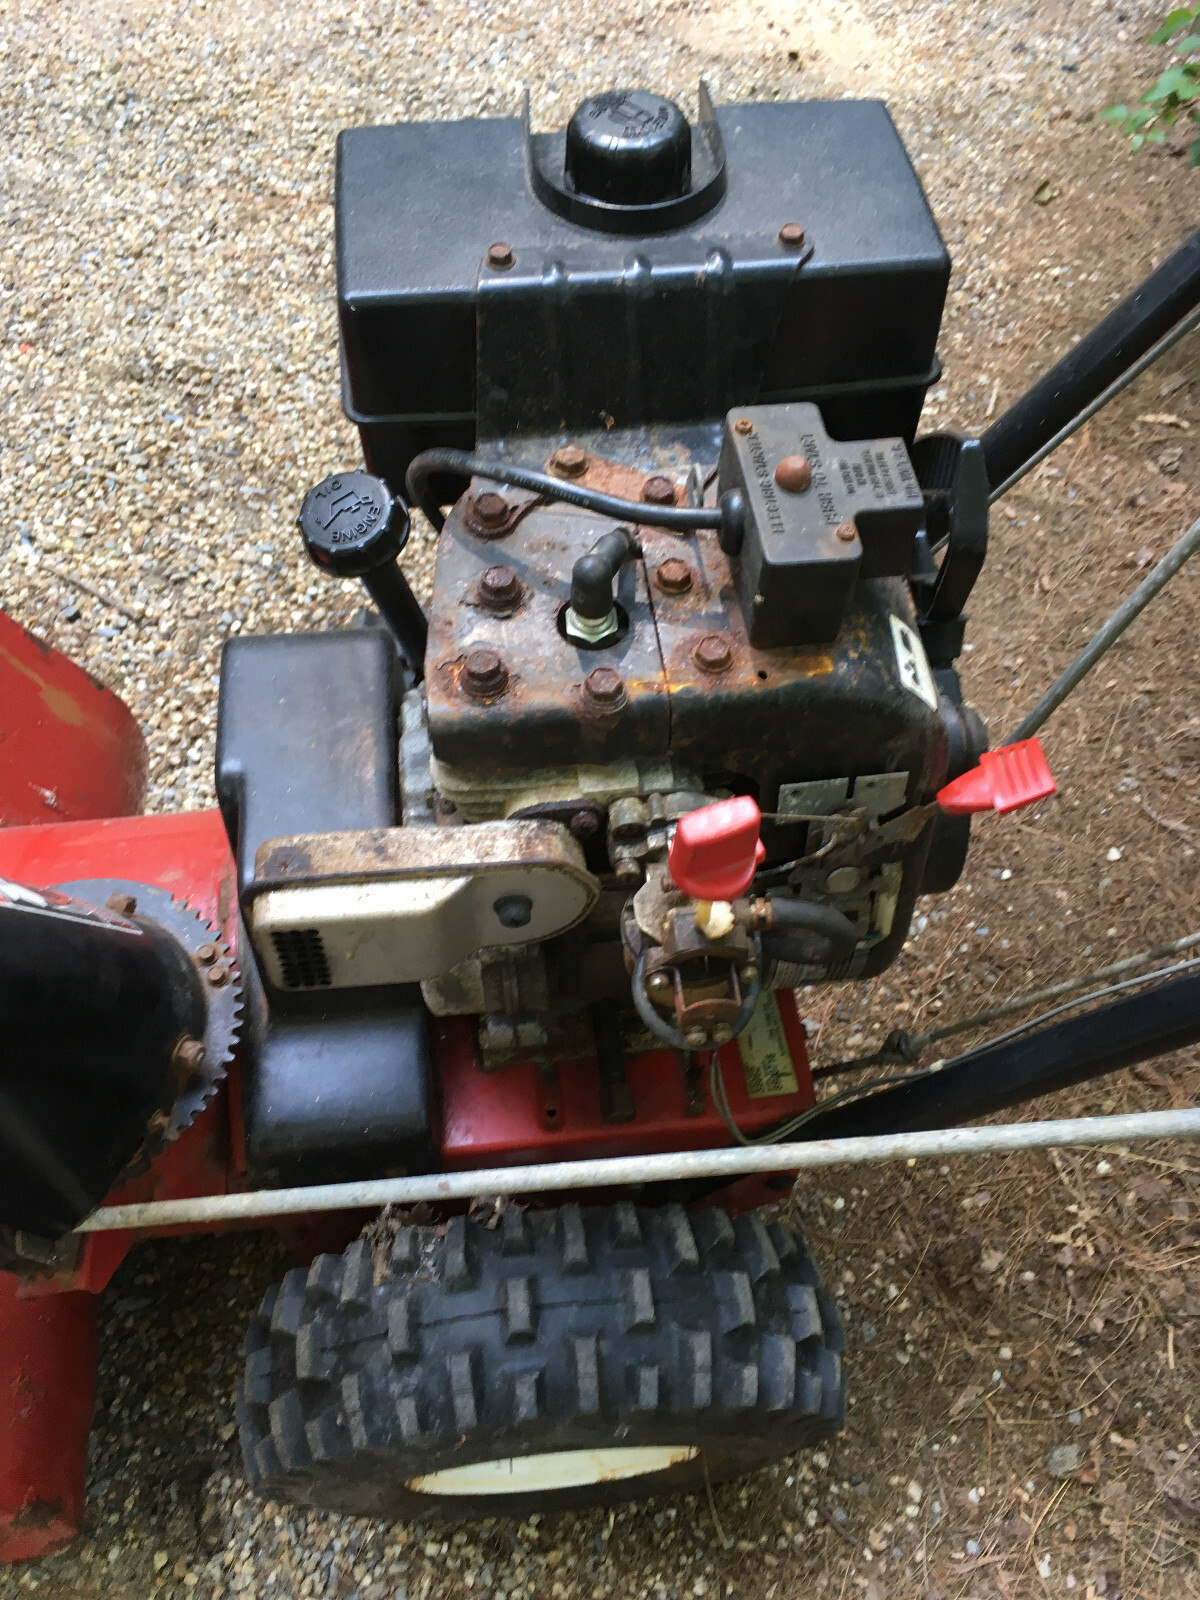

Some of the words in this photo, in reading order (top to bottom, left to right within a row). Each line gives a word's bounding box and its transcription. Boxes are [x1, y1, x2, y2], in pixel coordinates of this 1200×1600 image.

[800, 433, 822, 470] START
[315, 480, 342, 500] OIL
[812, 472, 828, 488] TO
[331, 506, 381, 542] ENGINE
[759, 480, 785, 535] ELECTRIC
[817, 492, 840, 526] PUSH
